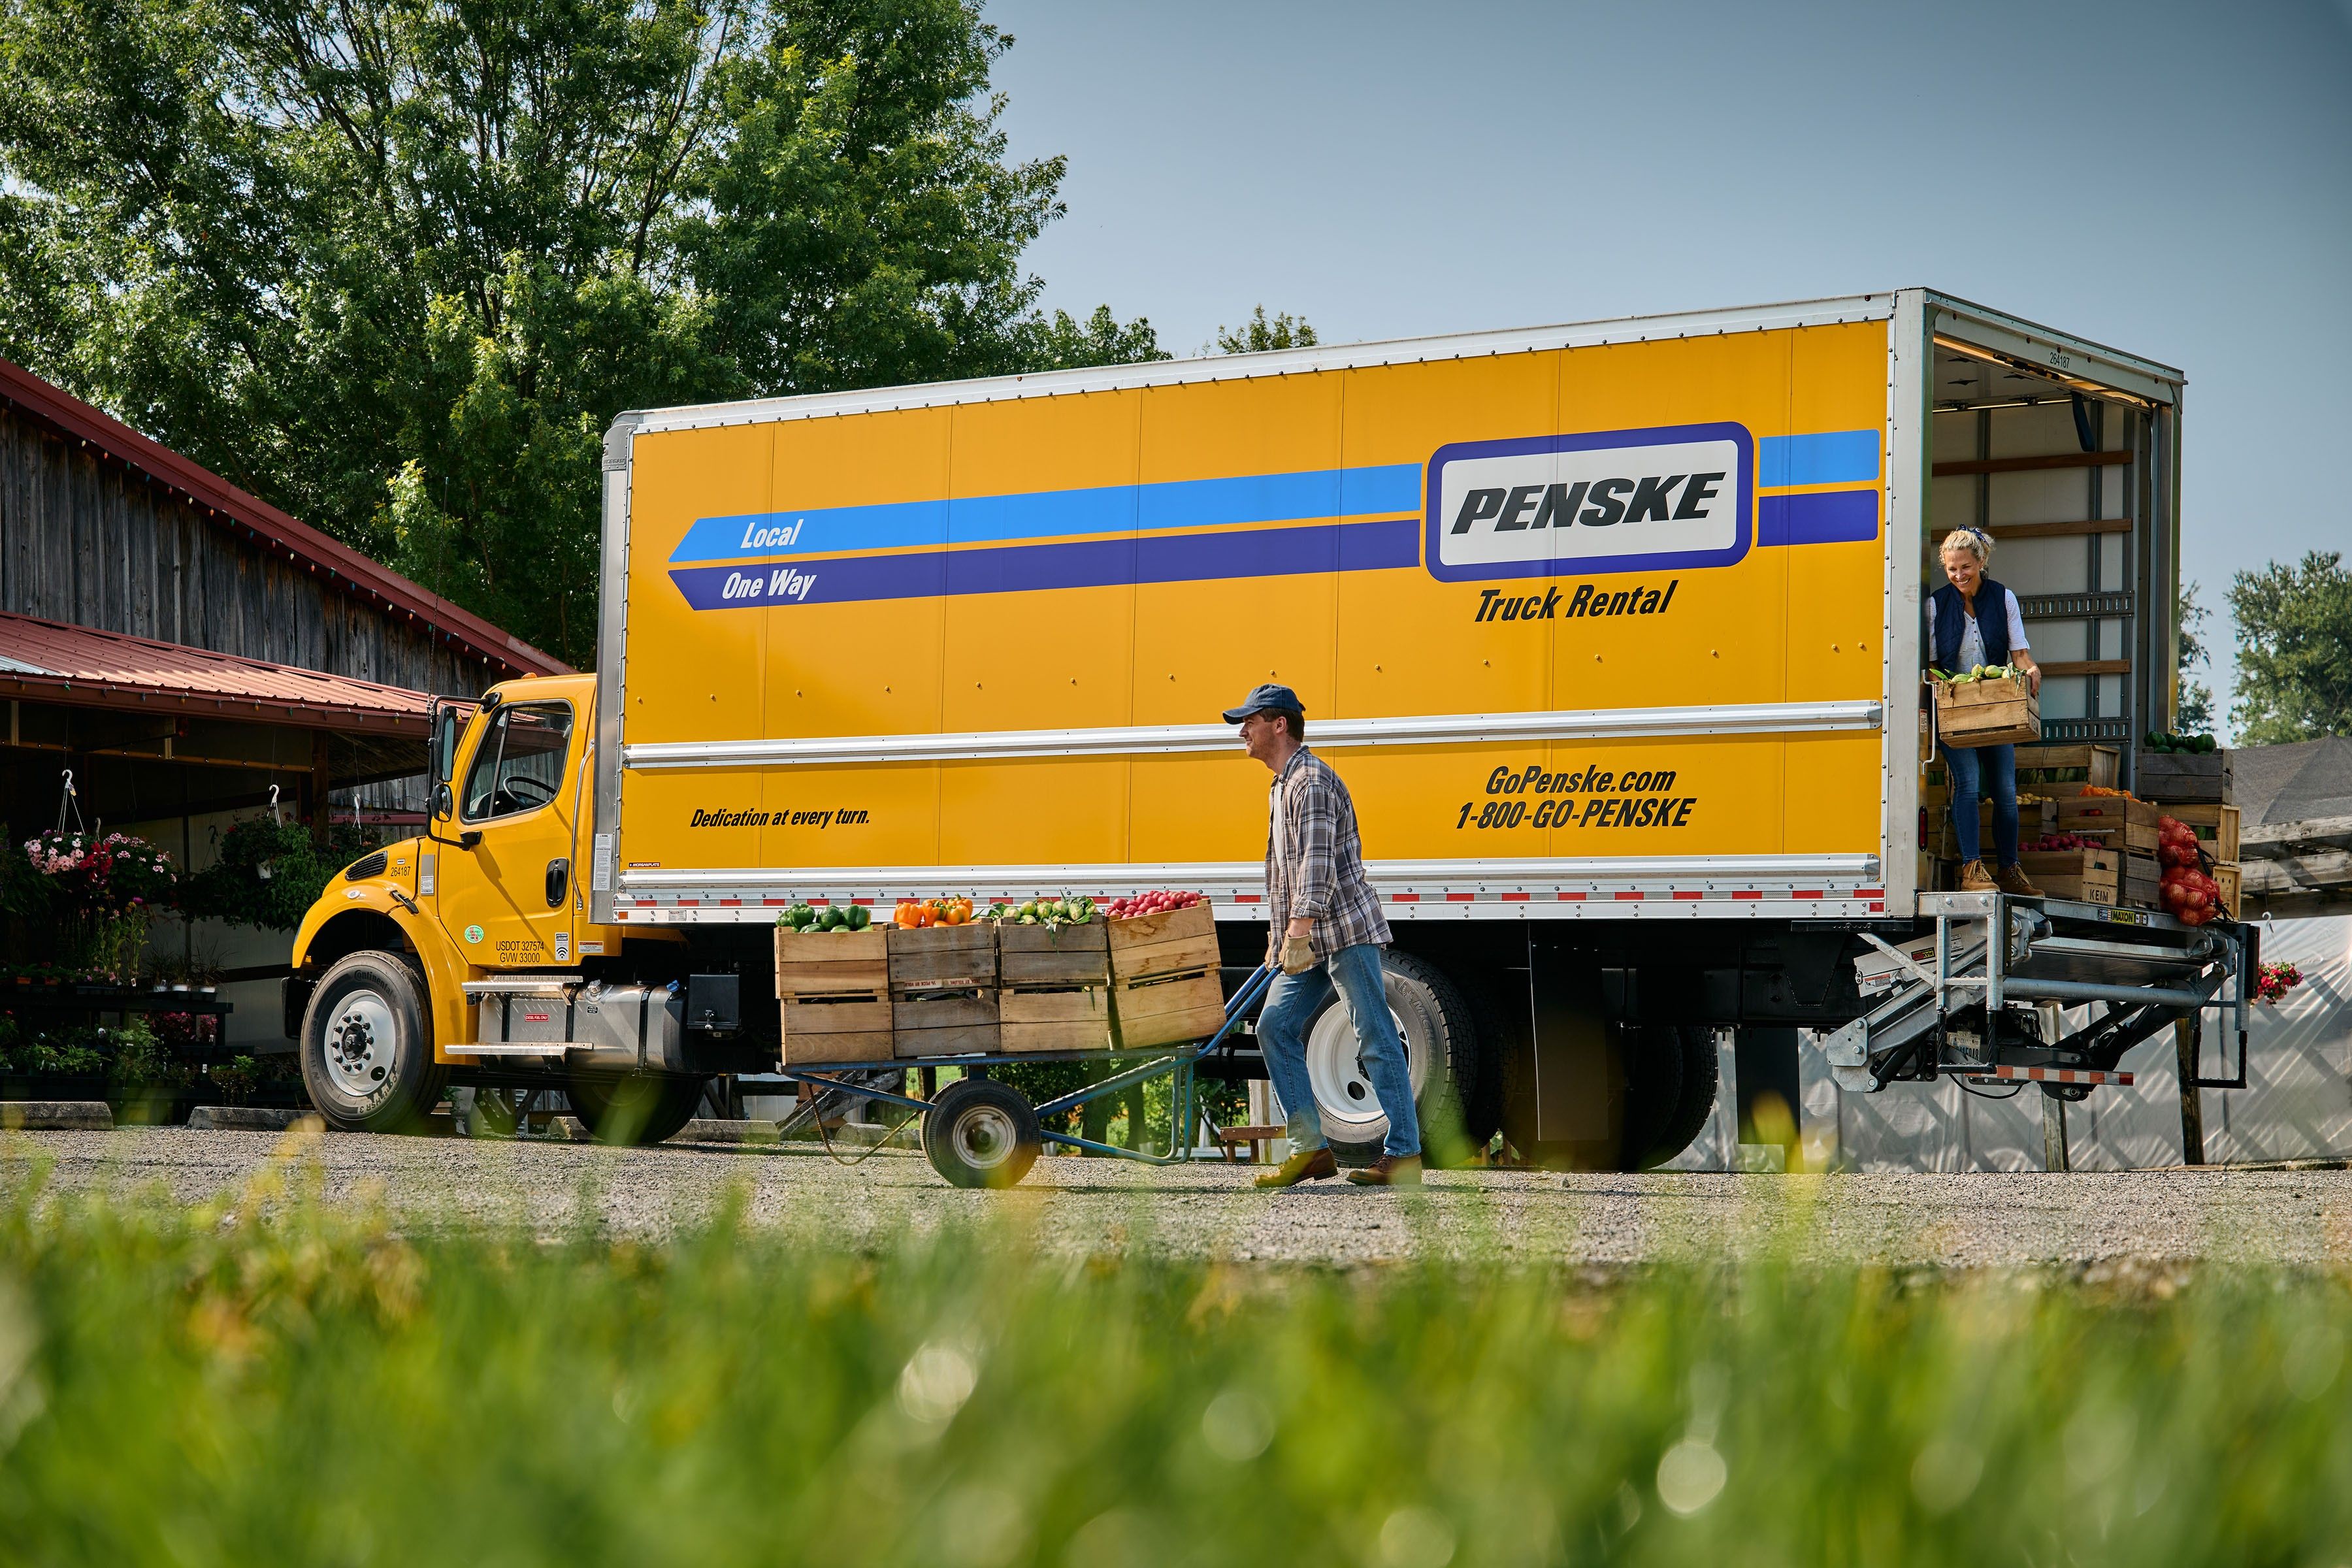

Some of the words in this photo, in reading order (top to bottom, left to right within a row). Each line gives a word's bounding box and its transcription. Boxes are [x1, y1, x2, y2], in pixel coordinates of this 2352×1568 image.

[2050, 351, 2070, 368] 264187
[1450, 472, 1726, 535] PENSKE
[740, 519, 804, 549] Local
[722, 572, 764, 599] One
[768, 568, 817, 601] Way
[1475, 585, 1564, 623] Truck
[1565, 580, 1679, 619] Rental
[1485, 764, 1677, 795] GoPenske.com
[690, 808, 770, 827] Dedication
[772, 809, 790, 825] at
[791, 810, 834, 829] every
[836, 808, 870, 824] turn.
[1456, 797, 1698, 830] 1-800-GO-PENSKE
[390, 866, 411, 877] 264187
[2089, 889, 2108, 902] KEIN
[2113, 910, 2133, 923] MAXON
[496, 941, 520, 951] USDOT
[521, 941, 544, 951] 327574
[500, 953, 519, 963] GVW
[519, 952, 540, 962] 33000
[354, 970, 393, 998] Continental
